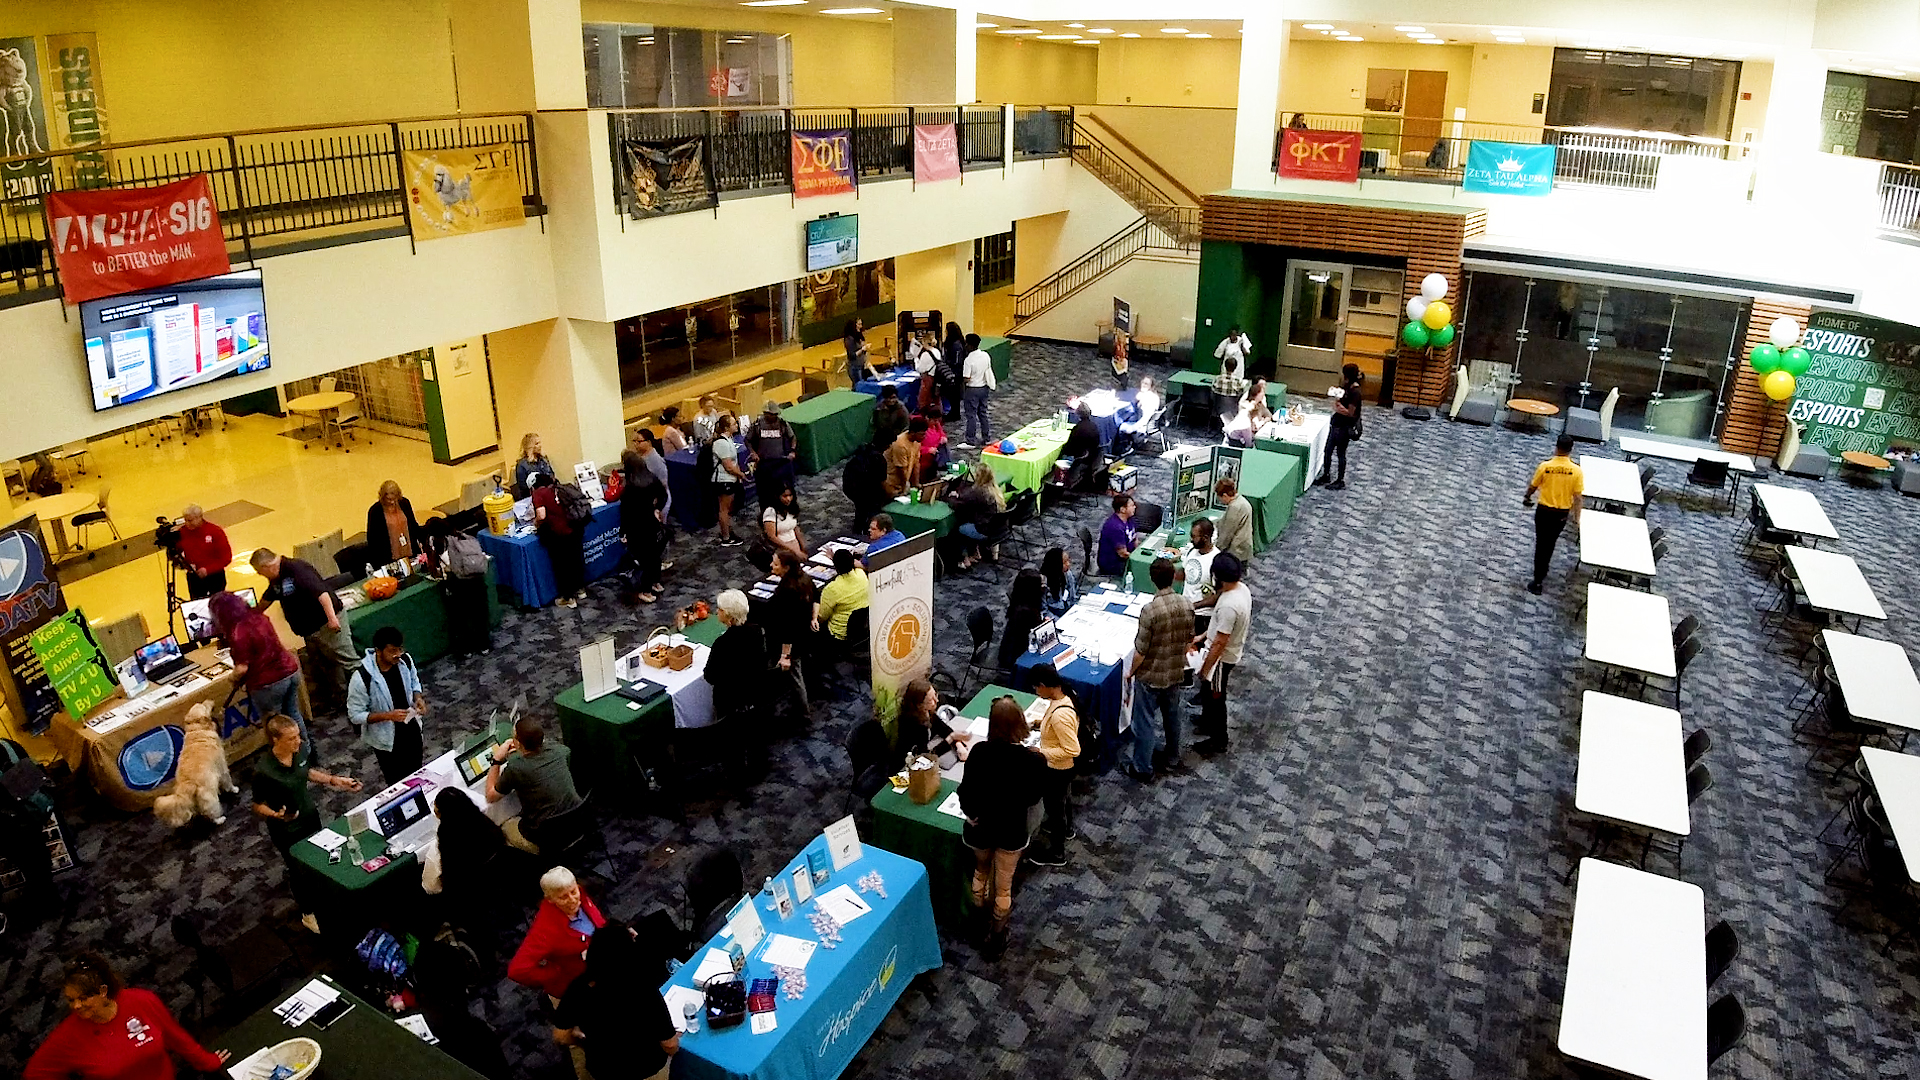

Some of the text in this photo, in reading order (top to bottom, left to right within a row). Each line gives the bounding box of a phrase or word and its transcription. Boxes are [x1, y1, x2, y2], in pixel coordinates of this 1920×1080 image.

[59, 47, 109, 190] RAIDERS
[1495, 171, 1514, 180] TAU
[1515, 173, 1549, 183] ALPHA
[54, 197, 211, 255] ALPHA SIG
[92, 242, 196, 275] to BETTER the MAN.
[1817, 316, 1861, 331] HOME OF
[1801, 328, 1875, 358] ESPORTS
[1806, 353, 1884, 384] ESPORTS
[1792, 376, 1856, 405] SPORTS
[1789, 400, 1865, 428] ESPORTS
[1808, 426, 1885, 455] ESPORTS
[37, 621, 66, 645] Keep
[40, 632, 79, 664] Access
[52, 647, 82, 676] Alive!
[60, 664, 99, 699] TV 4 U
[74, 696, 92, 712] By
[91, 684, 102, 697] U
[818, 977, 878, 1058] Hospice
